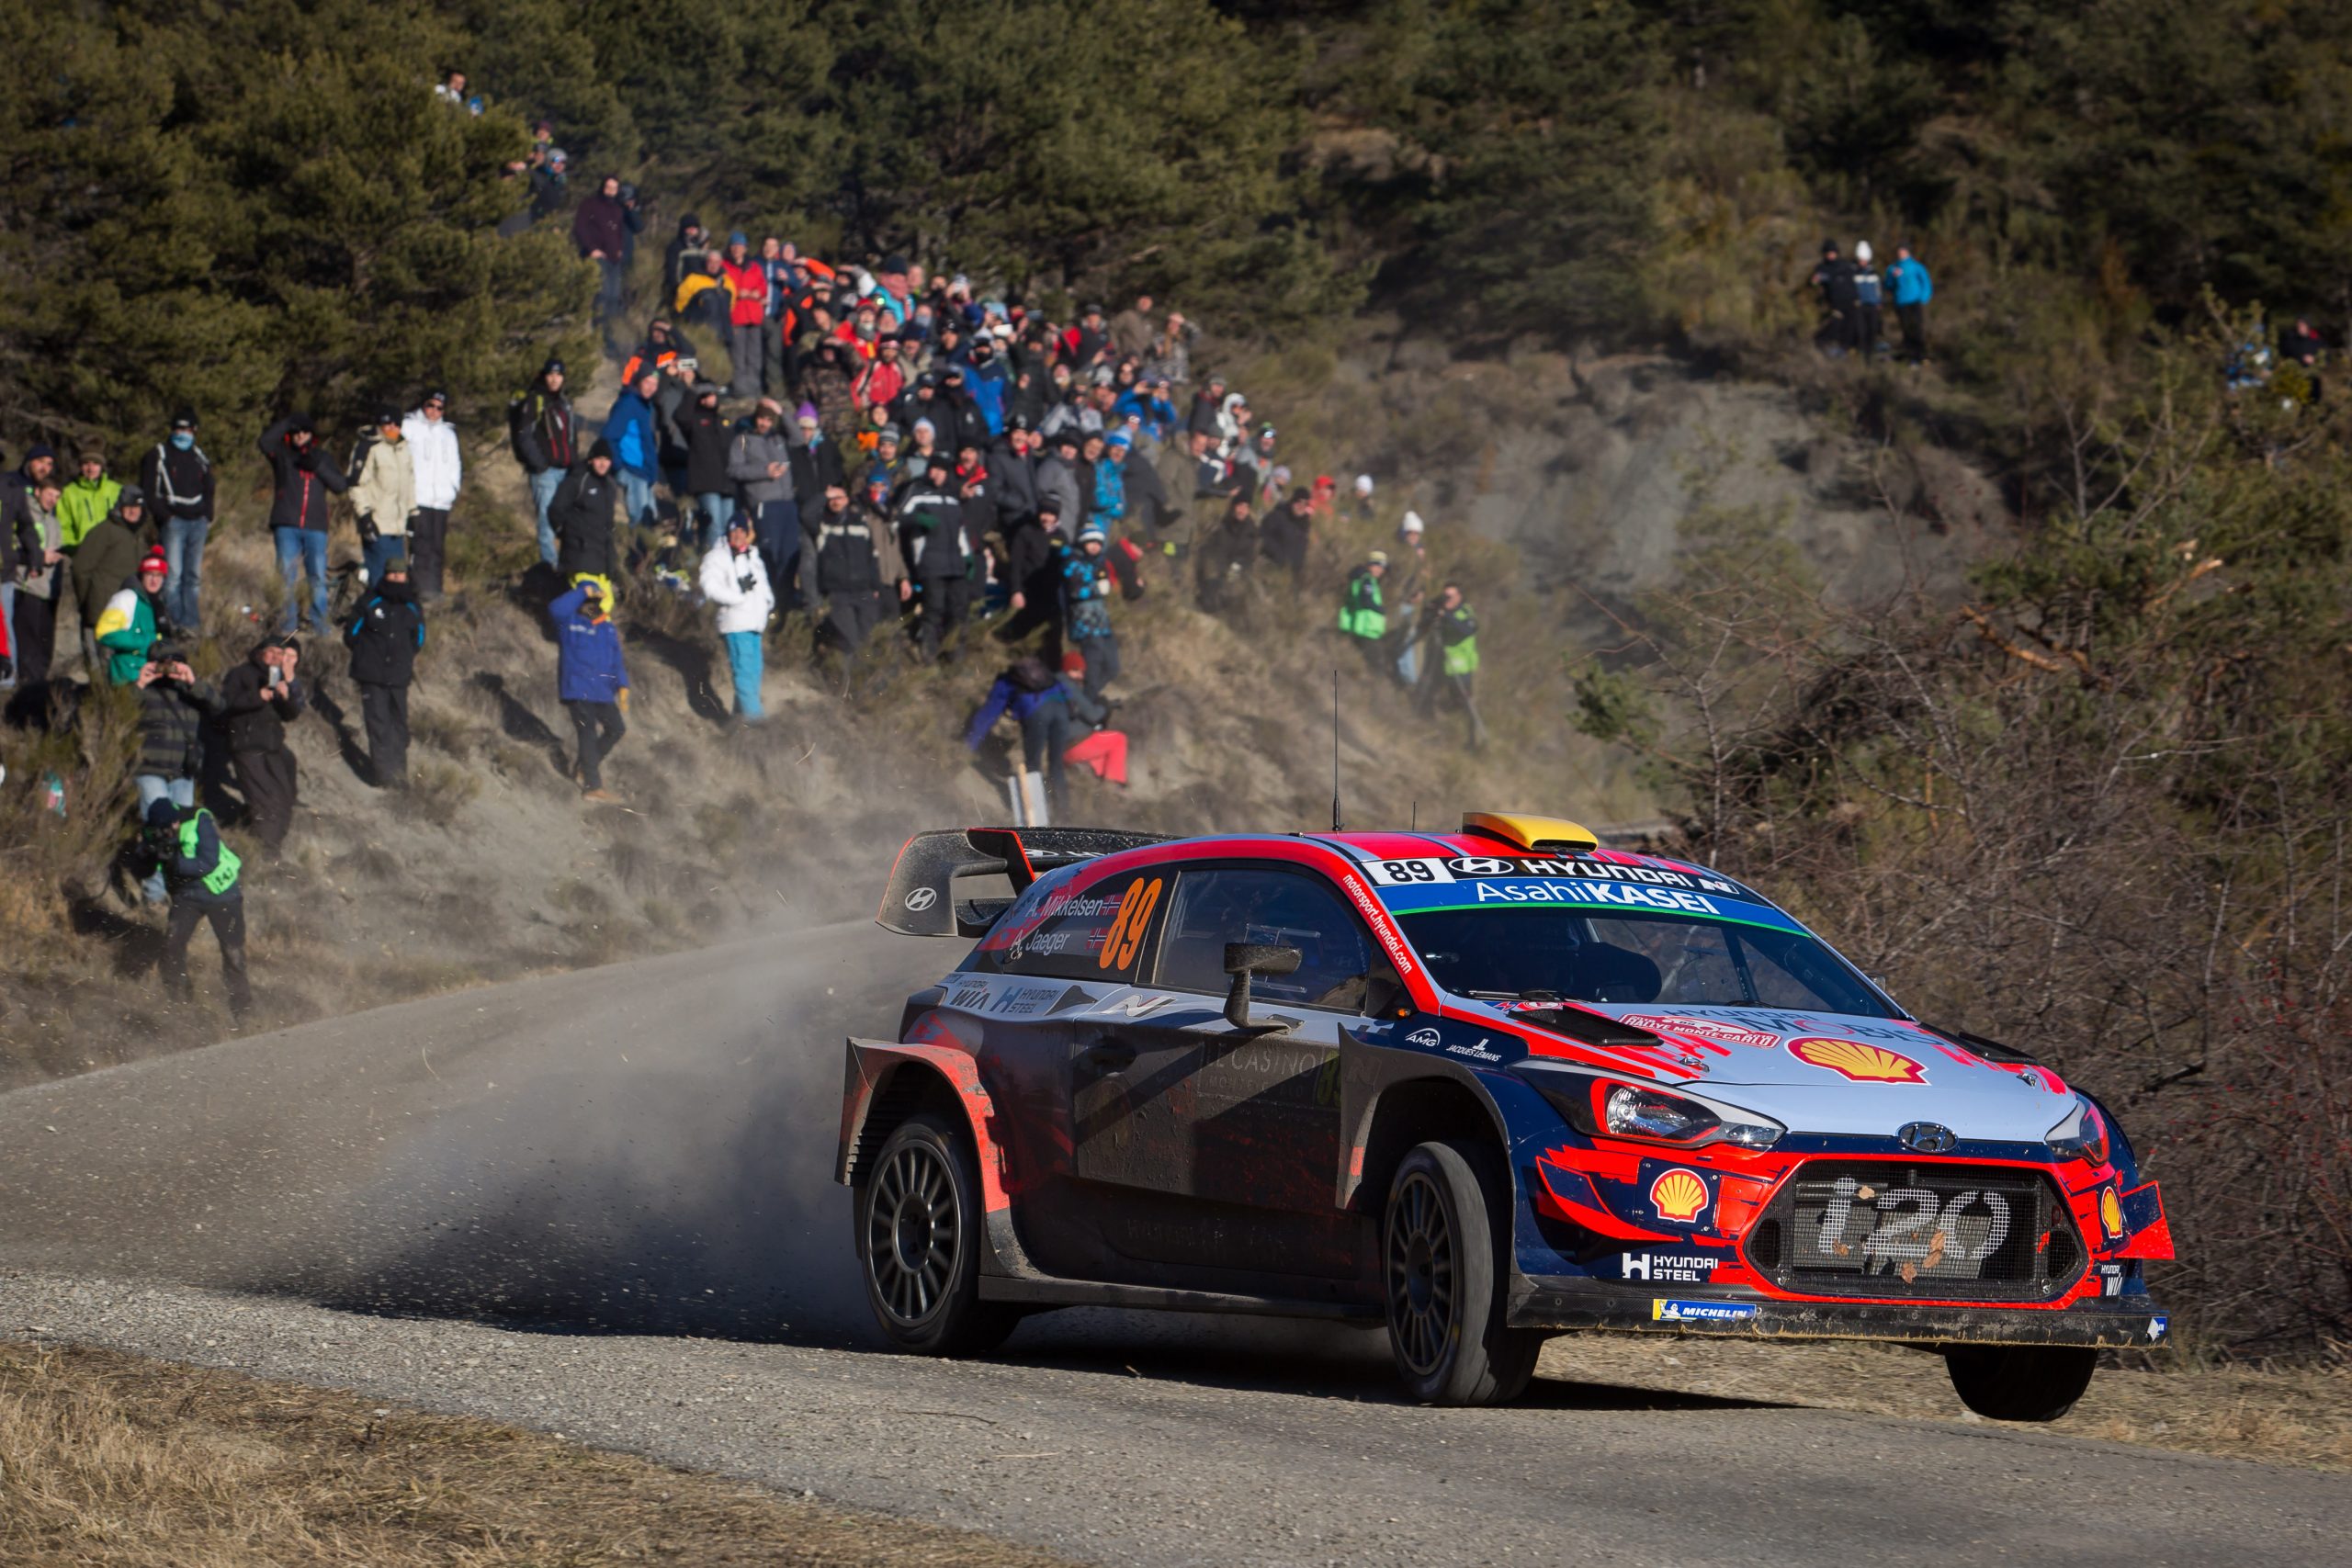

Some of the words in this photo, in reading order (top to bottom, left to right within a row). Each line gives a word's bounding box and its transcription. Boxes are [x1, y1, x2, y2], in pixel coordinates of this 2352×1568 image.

[1382, 860, 1435, 882] 89
[1520, 859, 1695, 887] HYUNDAI
[1025, 897, 1037, 918] A.
[1040, 895, 1103, 917] Mikkelsen
[1099, 877, 1163, 971] 89
[1342, 874, 1413, 975] motorsport.hyundai.com
[1010, 929, 1023, 951] A.
[1025, 929, 1071, 956] Jaeger
[949, 988, 990, 1010] WIA
[1017, 988, 1060, 1000] HYUNDAI
[1007, 1002, 1037, 1014] STEEL
[1662, 1010, 1820, 1021] HYUNDAI
[1624, 1017, 1672, 1032] RALLYE
[1730, 1016, 1946, 1047] MOBIS
[1405, 1034, 1438, 1047] AMG
[1230, 1048, 1317, 1077] CASINO
[1445, 1044, 1475, 1056] JACQUES
[1474, 1049, 1502, 1062] LEMANS
[1654, 1256, 1719, 1269] HYUNDAI
[1654, 1269, 1701, 1281] STEEL
[1682, 1307, 1747, 1318] MICHELIN
